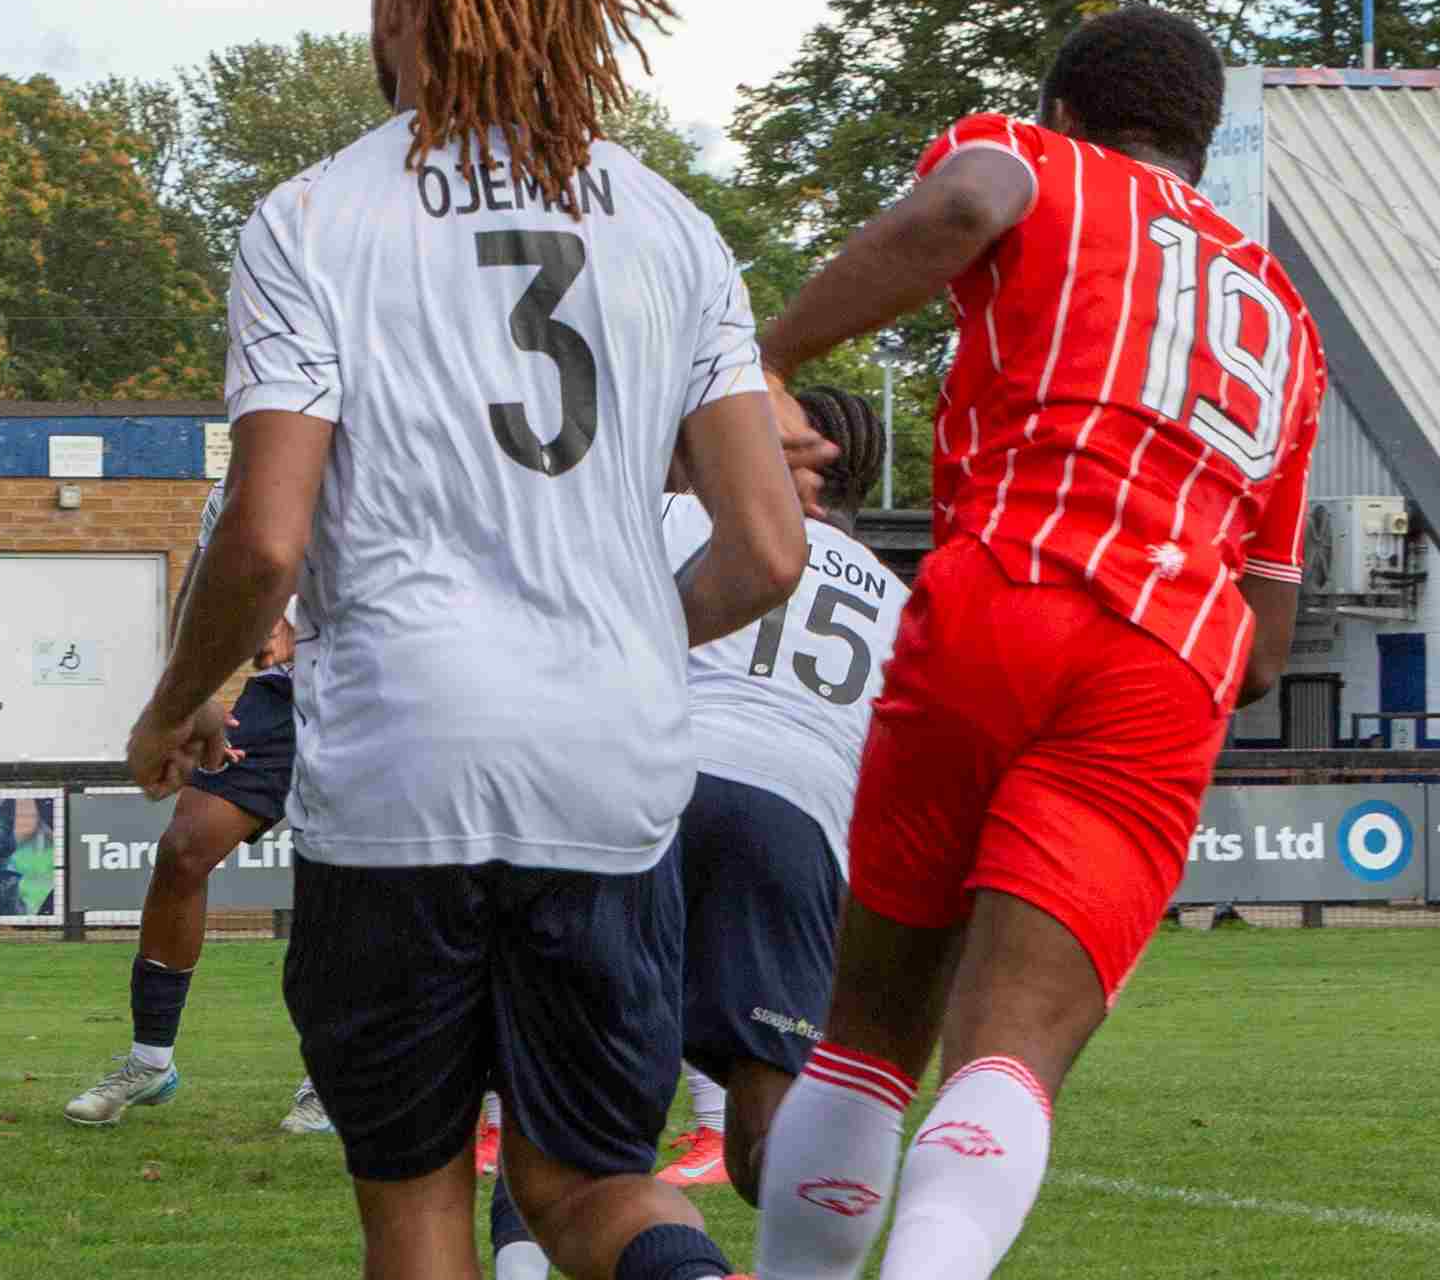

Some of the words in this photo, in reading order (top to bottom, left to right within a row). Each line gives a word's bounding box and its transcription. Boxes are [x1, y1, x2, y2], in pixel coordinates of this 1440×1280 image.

[417, 162, 614, 218] OJEMN
[474, 229, 598, 477] 3
[1141, 216, 1292, 481] 19
[807, 544, 886, 599] LSON
[748, 583, 872, 706] 15
[239, 830, 294, 868] Lif
[1188, 823, 1244, 862] fts
[1254, 822, 1325, 861] Ltd
